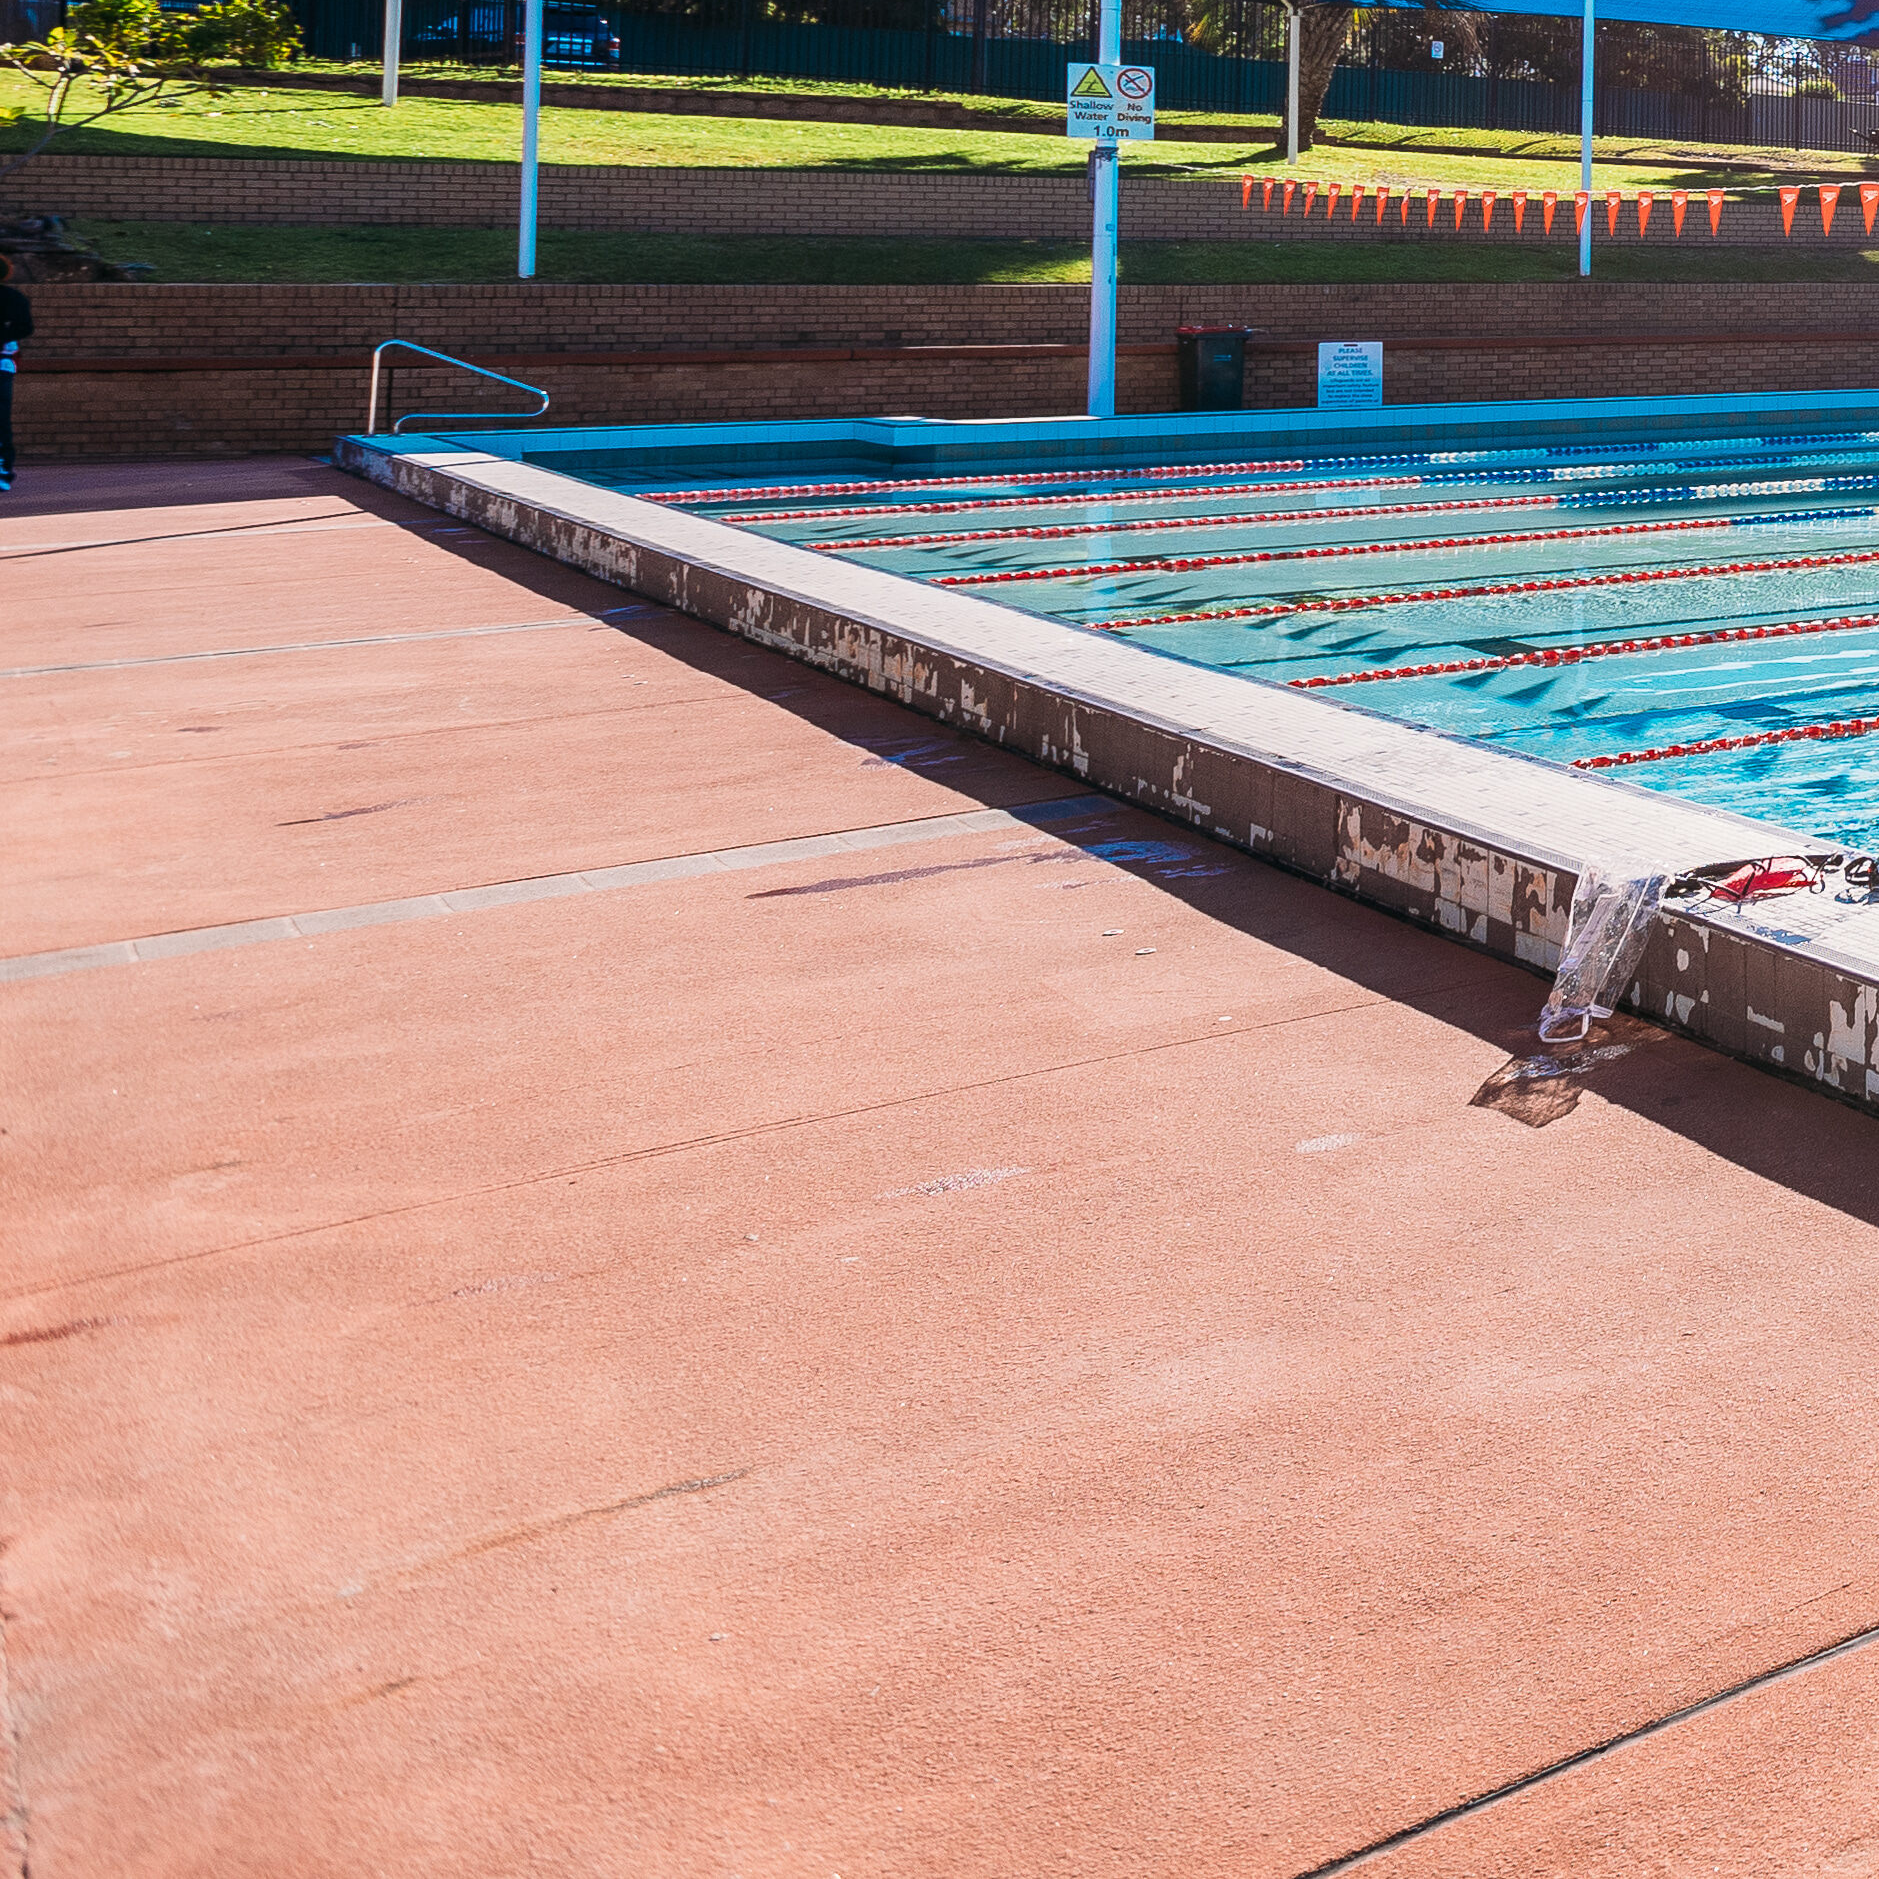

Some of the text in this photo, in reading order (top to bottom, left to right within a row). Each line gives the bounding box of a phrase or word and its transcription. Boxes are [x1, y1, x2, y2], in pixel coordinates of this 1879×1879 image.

[1070, 100, 1114, 110] Shallow
[1127, 103, 1143, 111] No
[1074, 111, 1109, 120] Water
[1117, 112, 1152, 124] Diving
[1093, 125, 1130, 137] 1.0m
